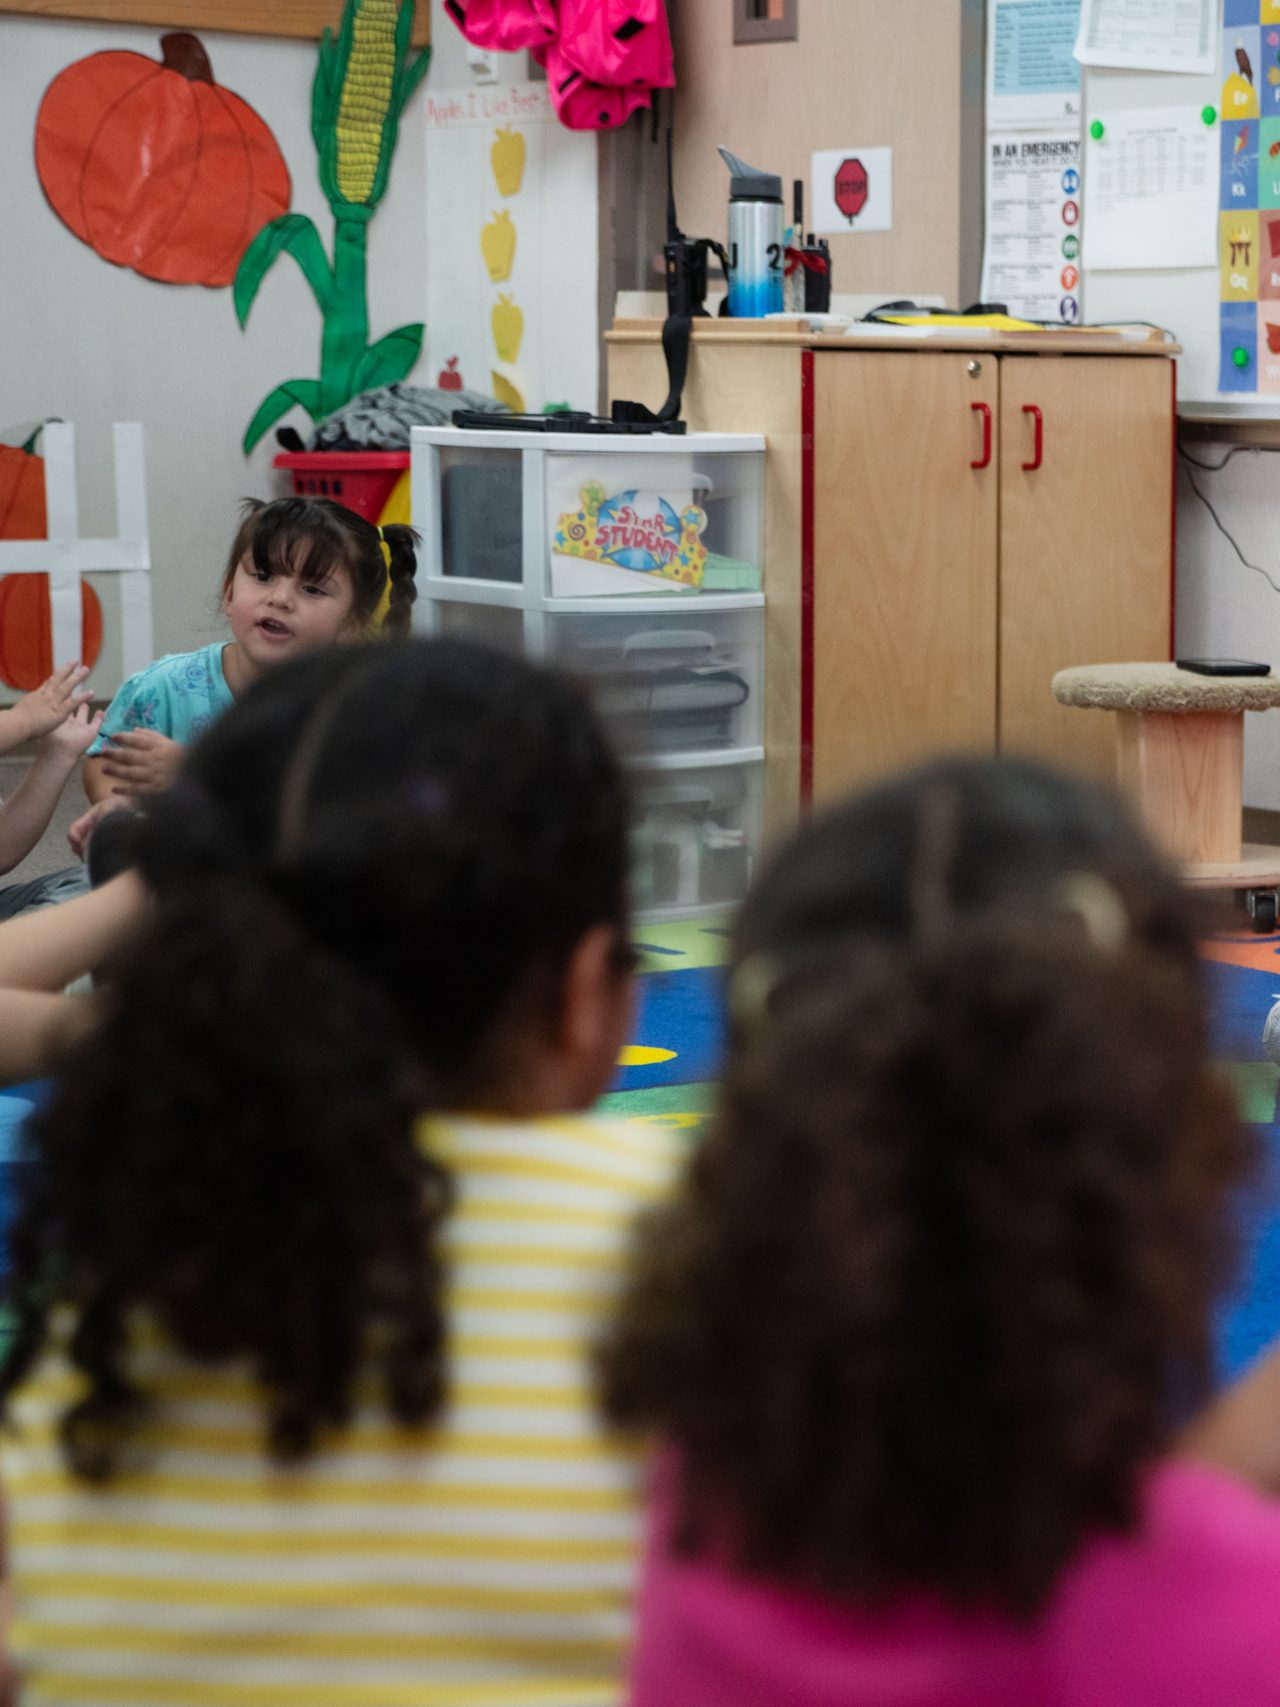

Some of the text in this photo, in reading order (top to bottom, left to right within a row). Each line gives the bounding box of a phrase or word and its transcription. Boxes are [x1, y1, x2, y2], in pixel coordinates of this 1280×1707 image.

[1022, 141, 1081, 157] EMERGENCY
[1232, 183, 1246, 196] Kk
[595, 525, 679, 562] STUDENT
